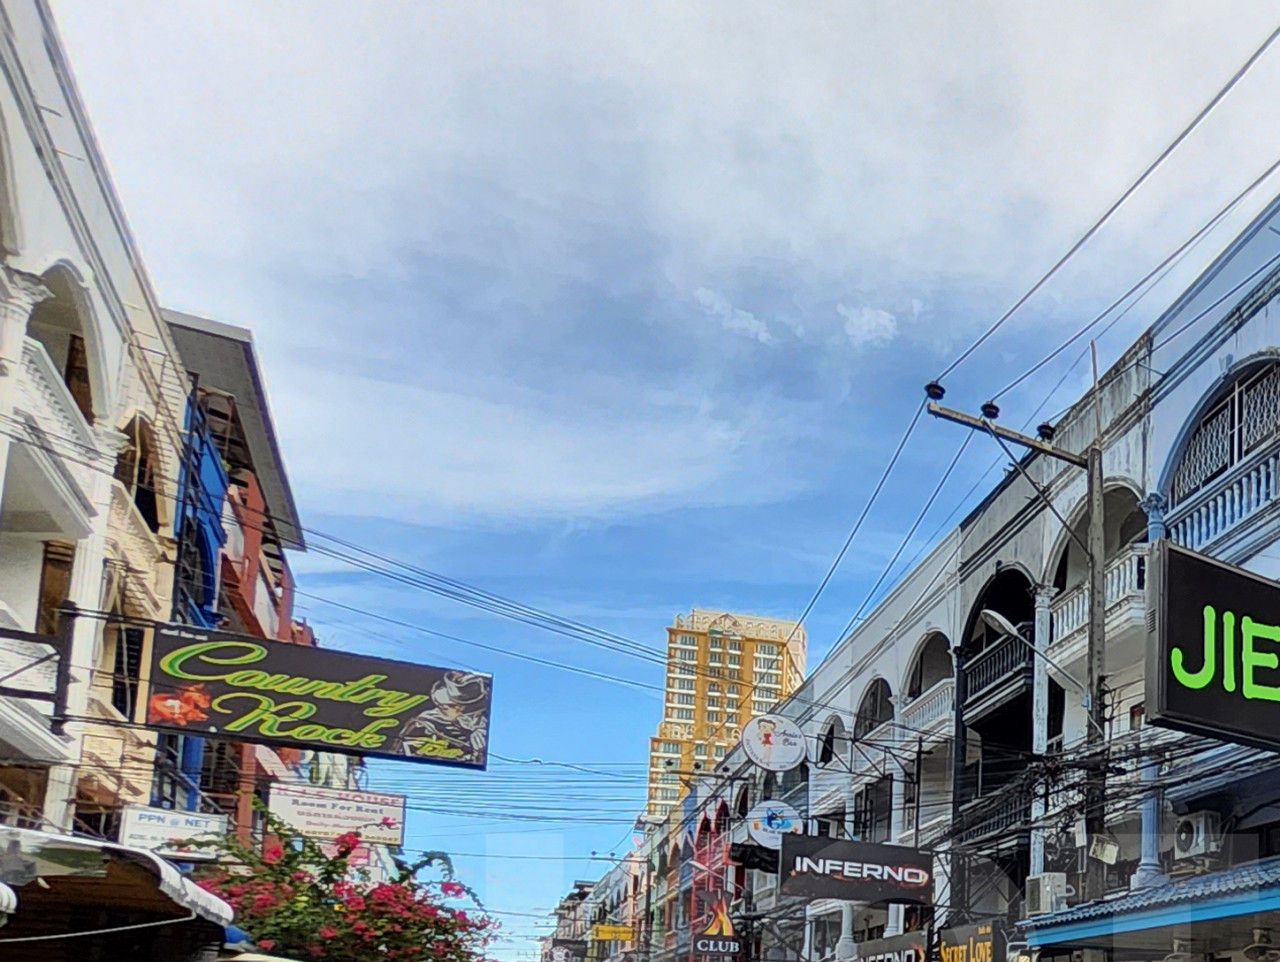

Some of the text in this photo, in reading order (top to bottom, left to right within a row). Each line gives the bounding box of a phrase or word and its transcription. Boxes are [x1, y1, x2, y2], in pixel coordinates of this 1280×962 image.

[159, 641, 429, 717] Country
[211, 692, 399, 747] Rock
[291, 799, 384, 814] Room For Rent
[138, 813, 166, 824] PPN
[185, 819, 210, 828] NET
[795, 856, 927, 884] INFERNO
[696, 939, 740, 953] CLUB
